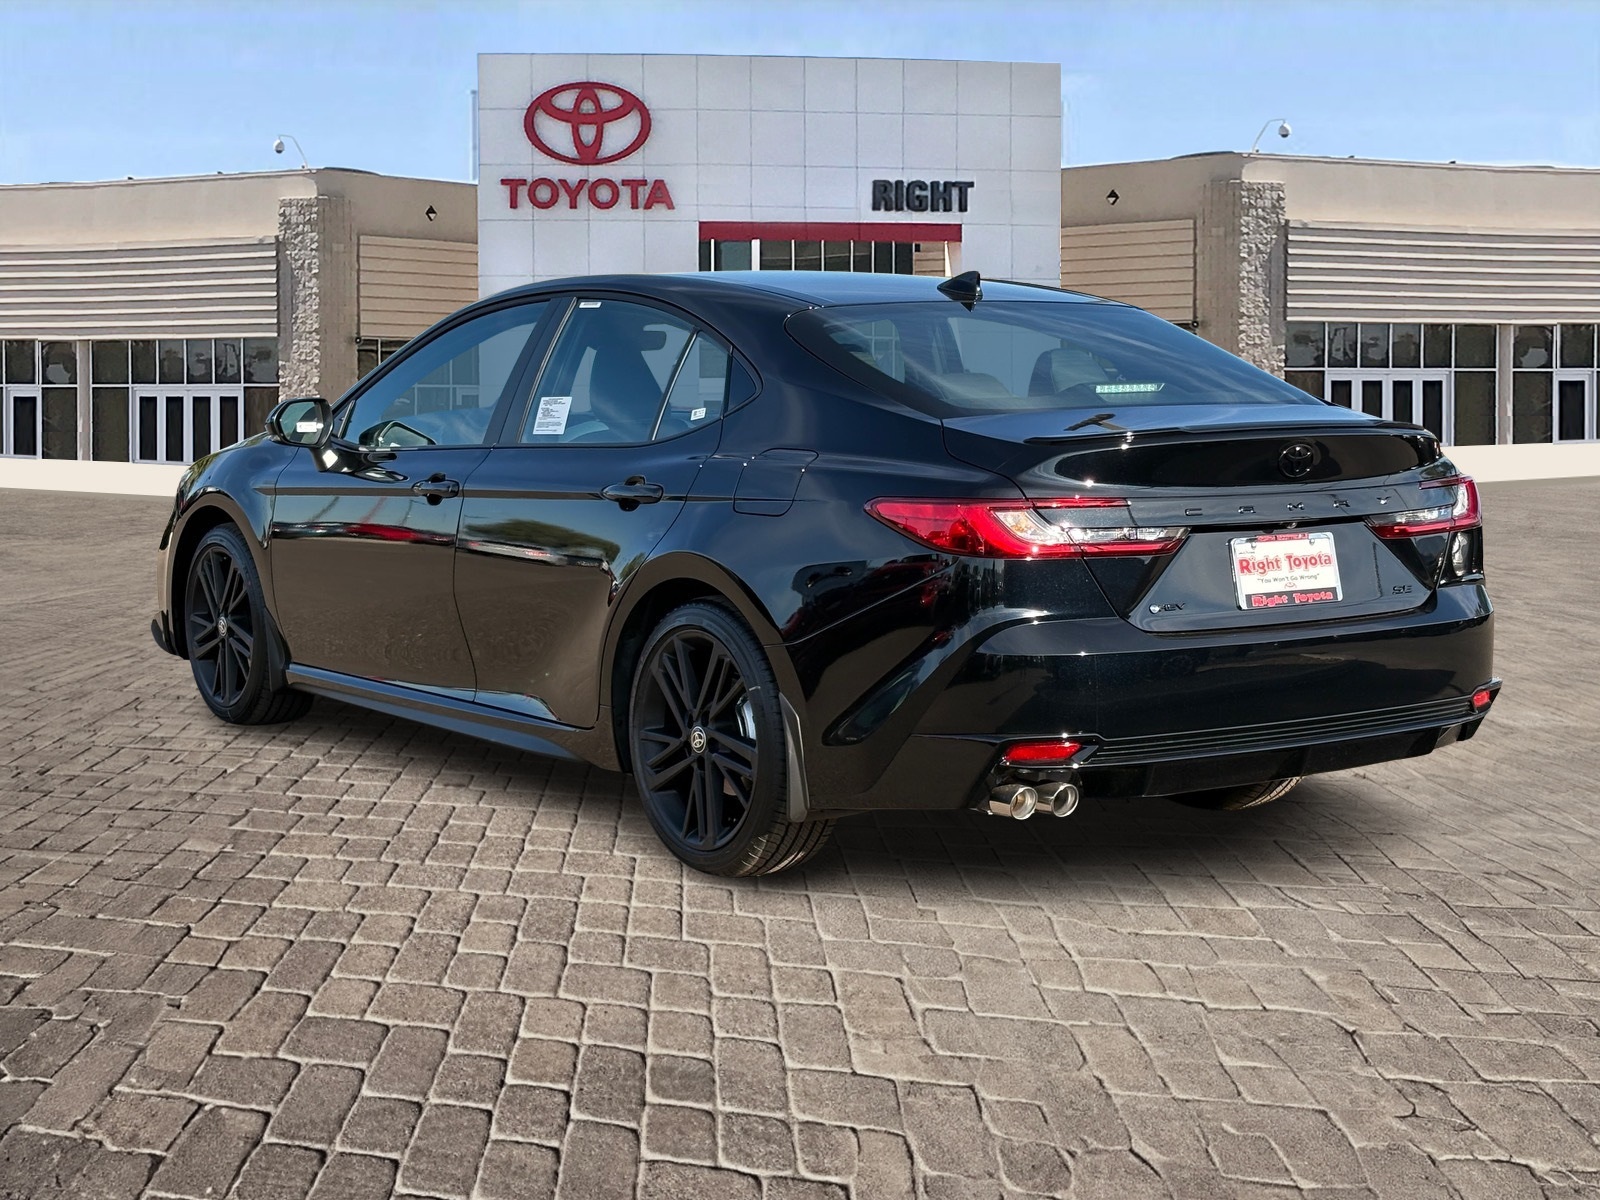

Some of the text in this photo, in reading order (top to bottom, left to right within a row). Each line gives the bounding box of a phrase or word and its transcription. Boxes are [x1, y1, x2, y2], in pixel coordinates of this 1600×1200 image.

[500, 178, 675, 209] TOYOTA
[872, 180, 974, 212] RIGHT
[1185, 496, 1391, 516] CAMRY
[1239, 552, 1332, 575] Right Toyota
[1252, 591, 1333, 607] Right Toyota
[1392, 585, 1412, 595] SE
